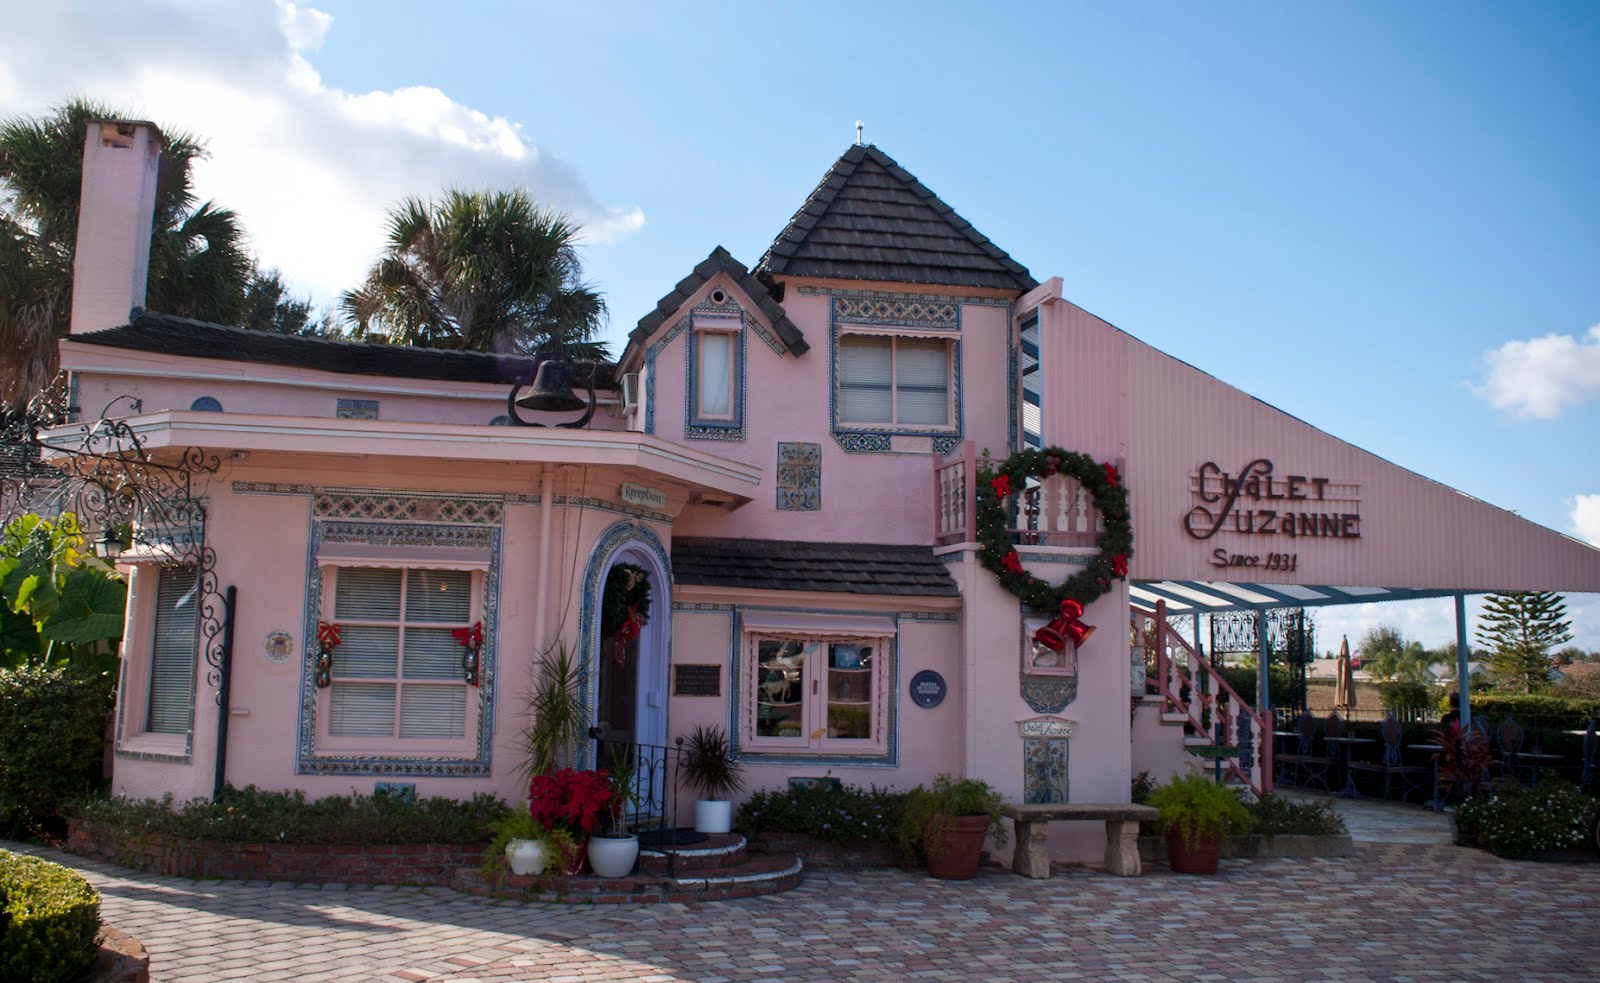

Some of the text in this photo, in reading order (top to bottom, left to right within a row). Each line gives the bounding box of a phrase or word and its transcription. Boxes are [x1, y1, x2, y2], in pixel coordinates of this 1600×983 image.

[625, 485, 664, 504] Reception
[1213, 548, 1298, 572] Since 1931
